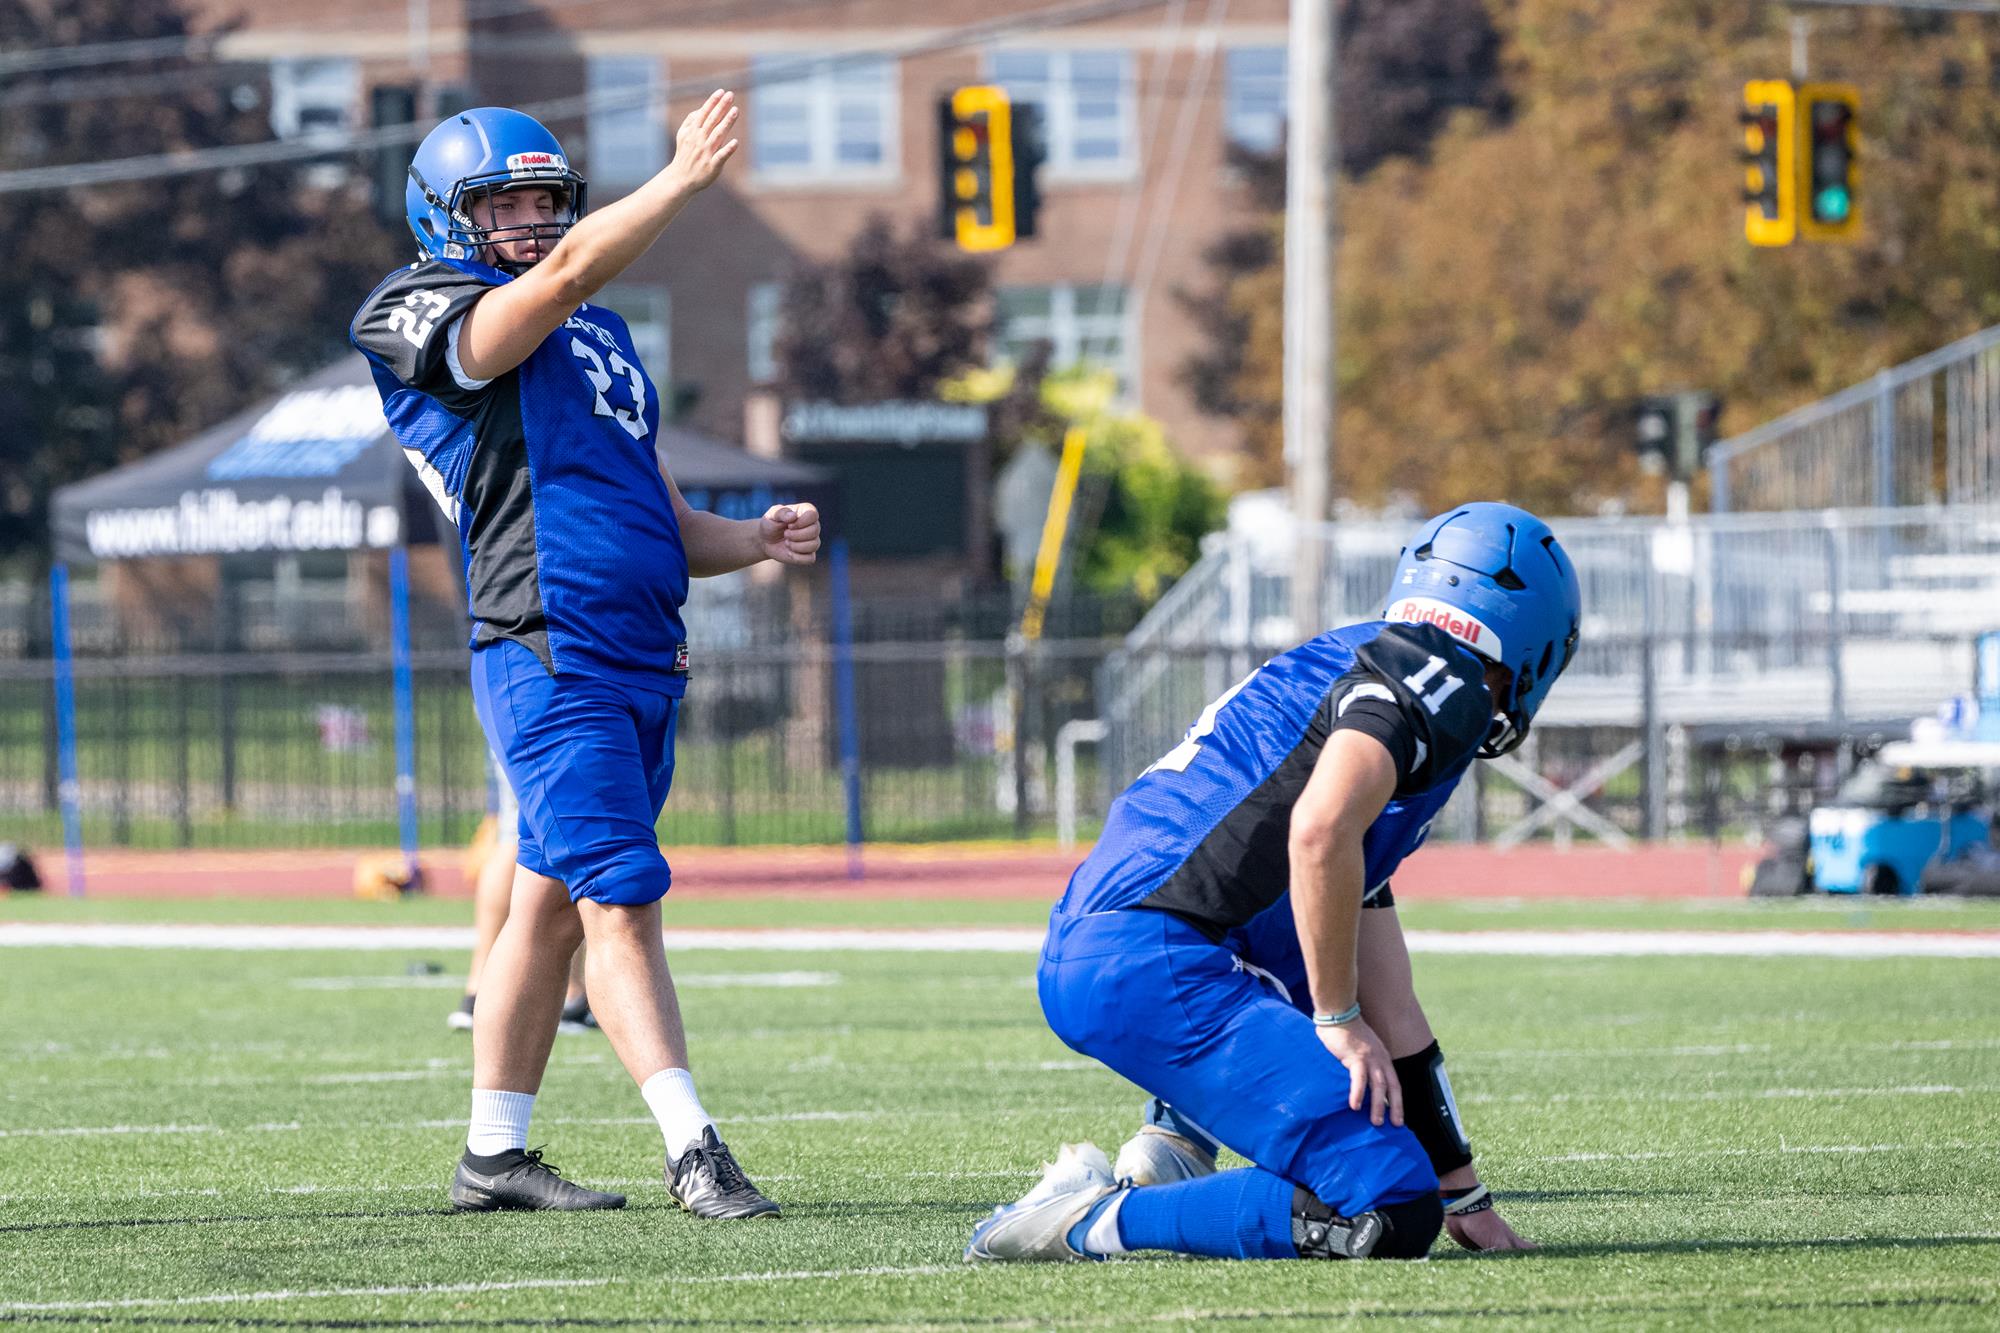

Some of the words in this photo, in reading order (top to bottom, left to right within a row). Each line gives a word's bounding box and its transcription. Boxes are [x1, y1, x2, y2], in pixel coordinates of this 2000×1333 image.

[520, 154, 552, 165] Riddell
[387, 288, 451, 350] 23
[570, 336, 649, 441] 23
[86, 486, 364, 559] www.hilbert.edu
[1401, 602, 1482, 644] Riddell
[1402, 654, 1466, 716] 11
